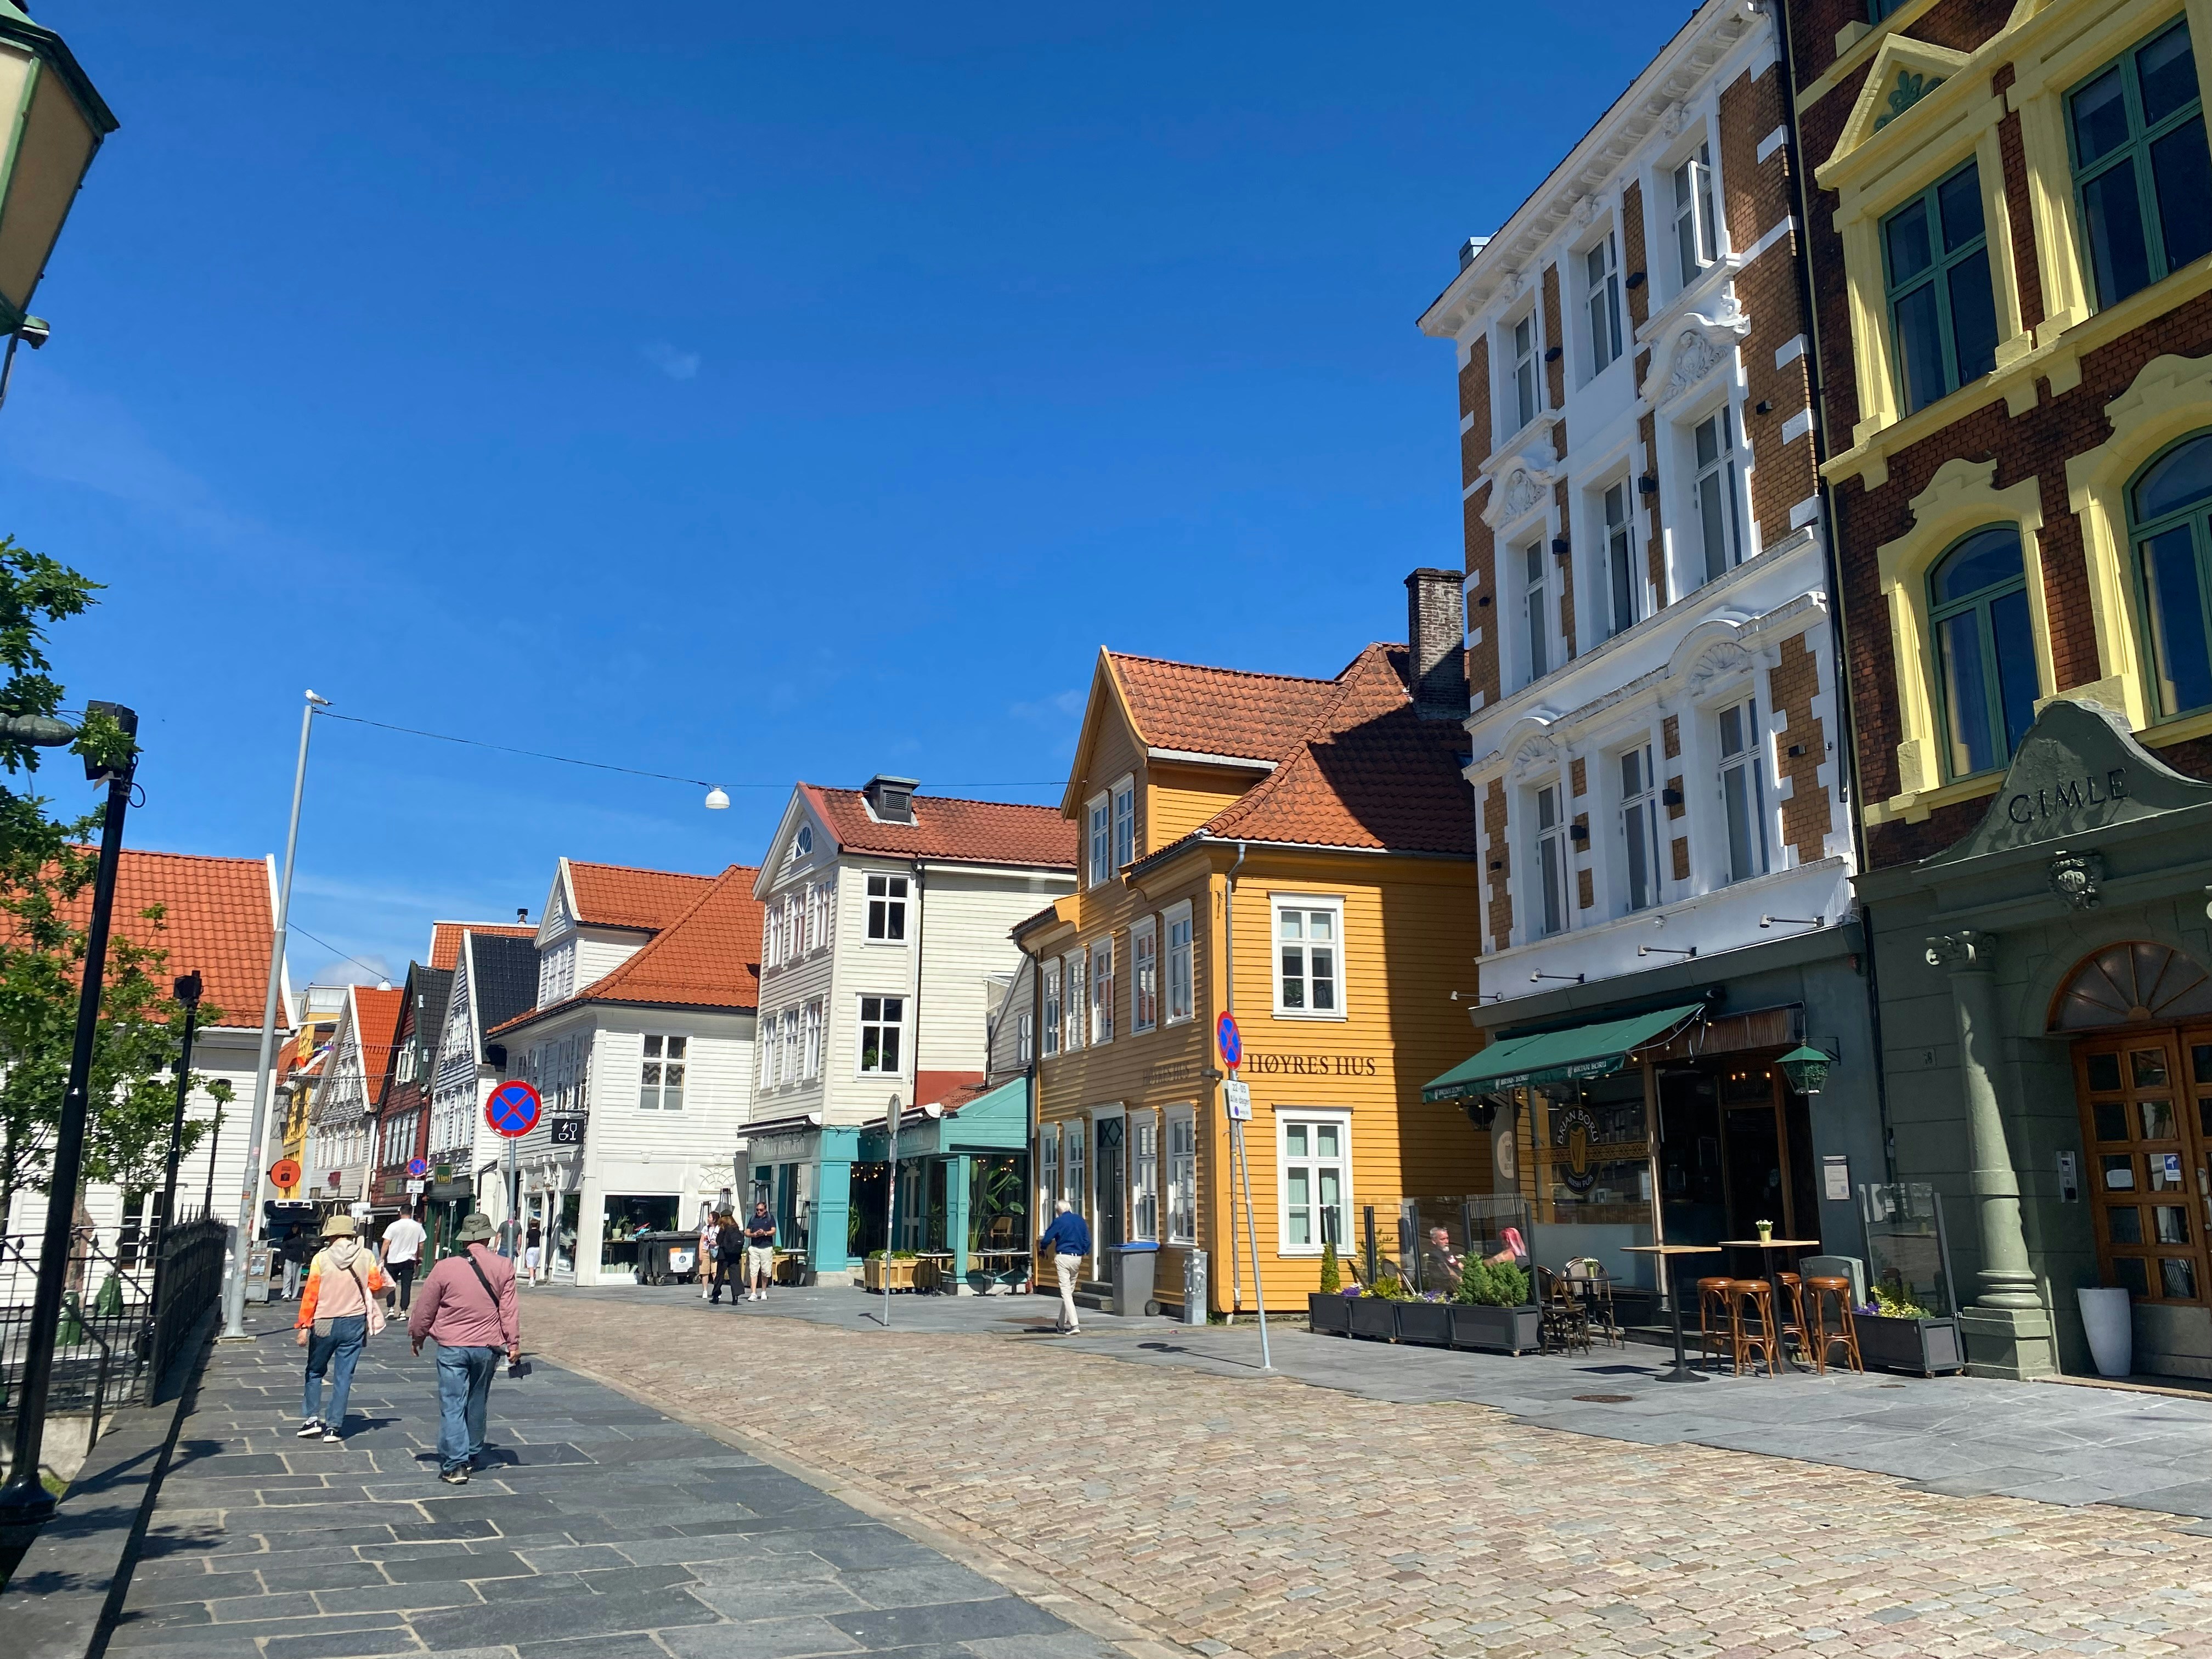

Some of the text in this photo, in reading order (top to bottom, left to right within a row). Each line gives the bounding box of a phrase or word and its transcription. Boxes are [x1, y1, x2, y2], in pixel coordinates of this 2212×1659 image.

[2008, 768, 2131, 824] GIMLE
[1248, 1054, 1375, 1076] HØYRES HUS
[1573, 1064, 1590, 1073] BRIAN
[1591, 1060, 1607, 1070] BORU
[1500, 1077, 1515, 1086] BRIAN
[1557, 1110, 1599, 1145] BRIAN BORU
[1582, 1175, 1594, 1188] PUB
